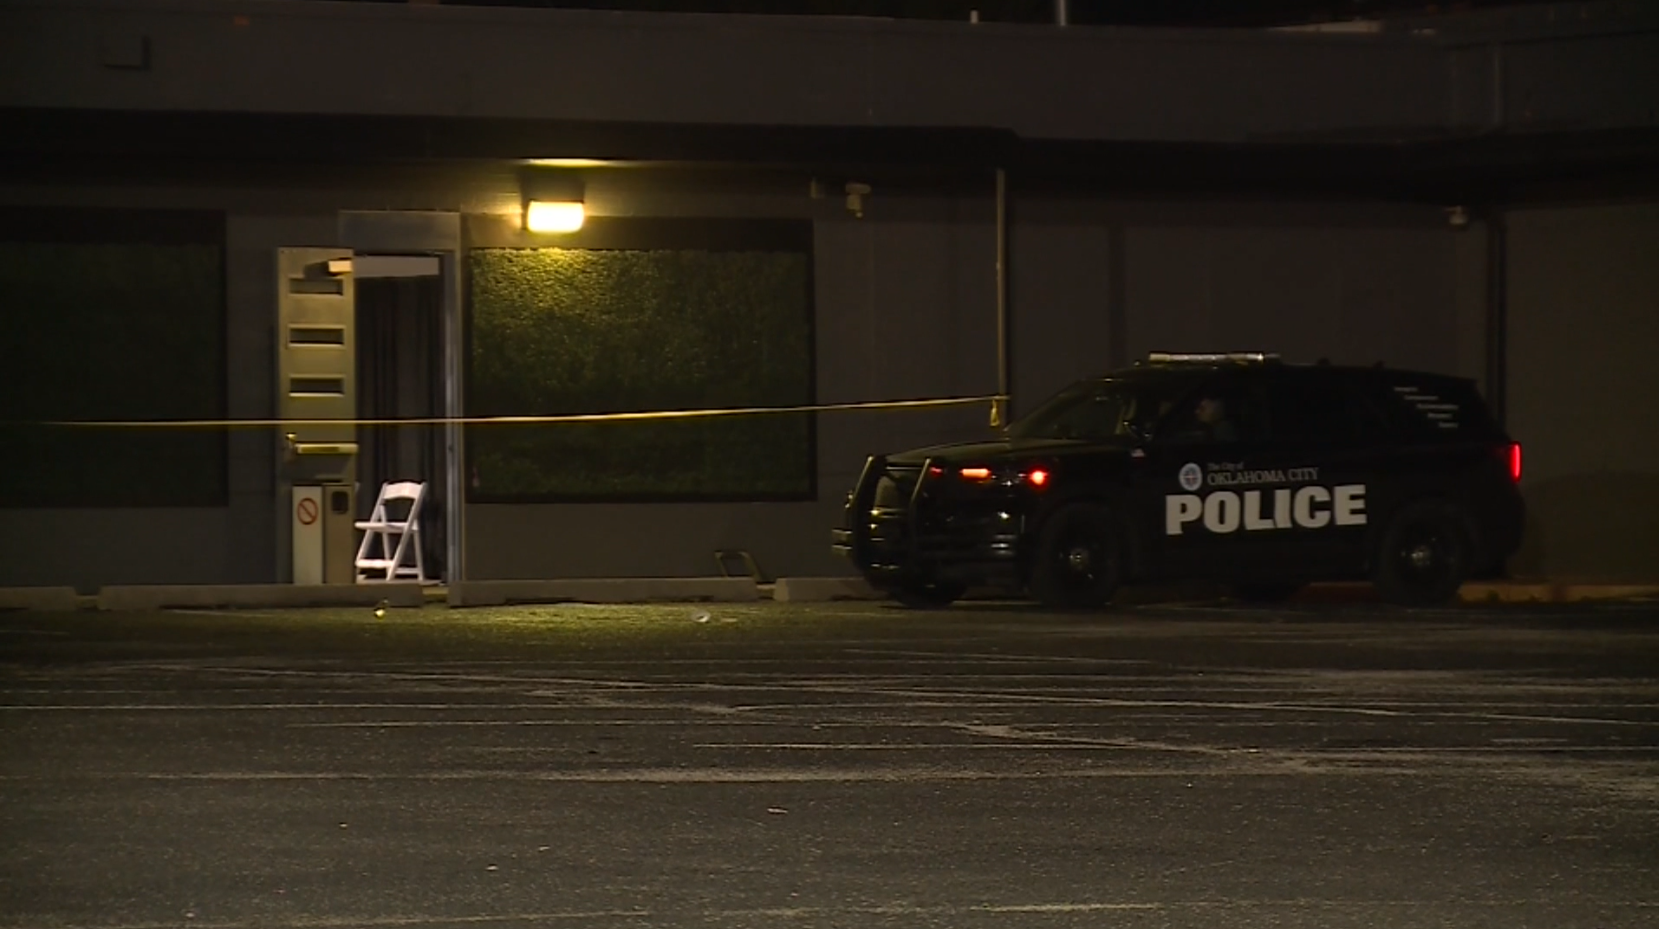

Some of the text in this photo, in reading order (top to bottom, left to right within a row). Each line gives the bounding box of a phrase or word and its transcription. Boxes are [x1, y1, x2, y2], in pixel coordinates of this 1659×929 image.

[1207, 467, 1319, 486] OKLAHOMA CITY
[1165, 484, 1368, 535] POLICE
